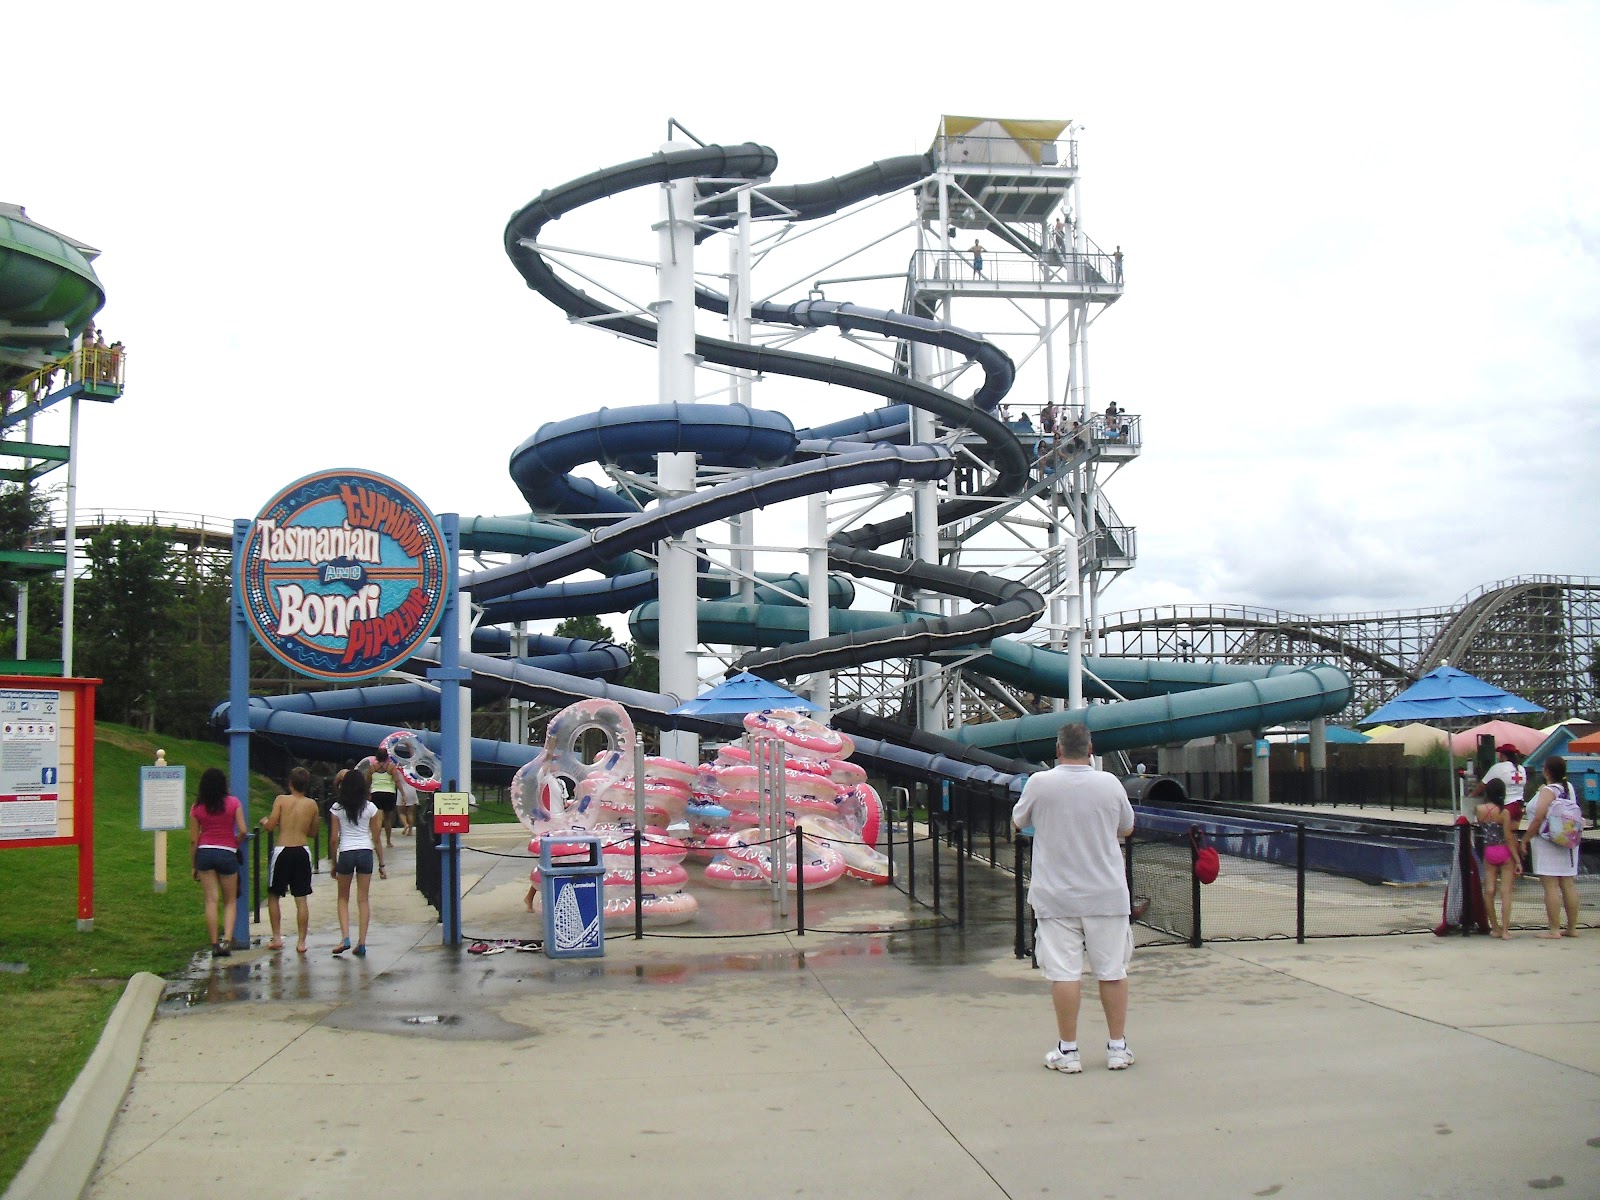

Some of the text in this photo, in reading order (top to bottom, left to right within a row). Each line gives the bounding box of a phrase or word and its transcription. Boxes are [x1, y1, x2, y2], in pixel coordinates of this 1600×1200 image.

[256, 518, 381, 565] Tasmanian
[325, 566, 361, 581] AND
[276, 583, 380, 637] Bondi
